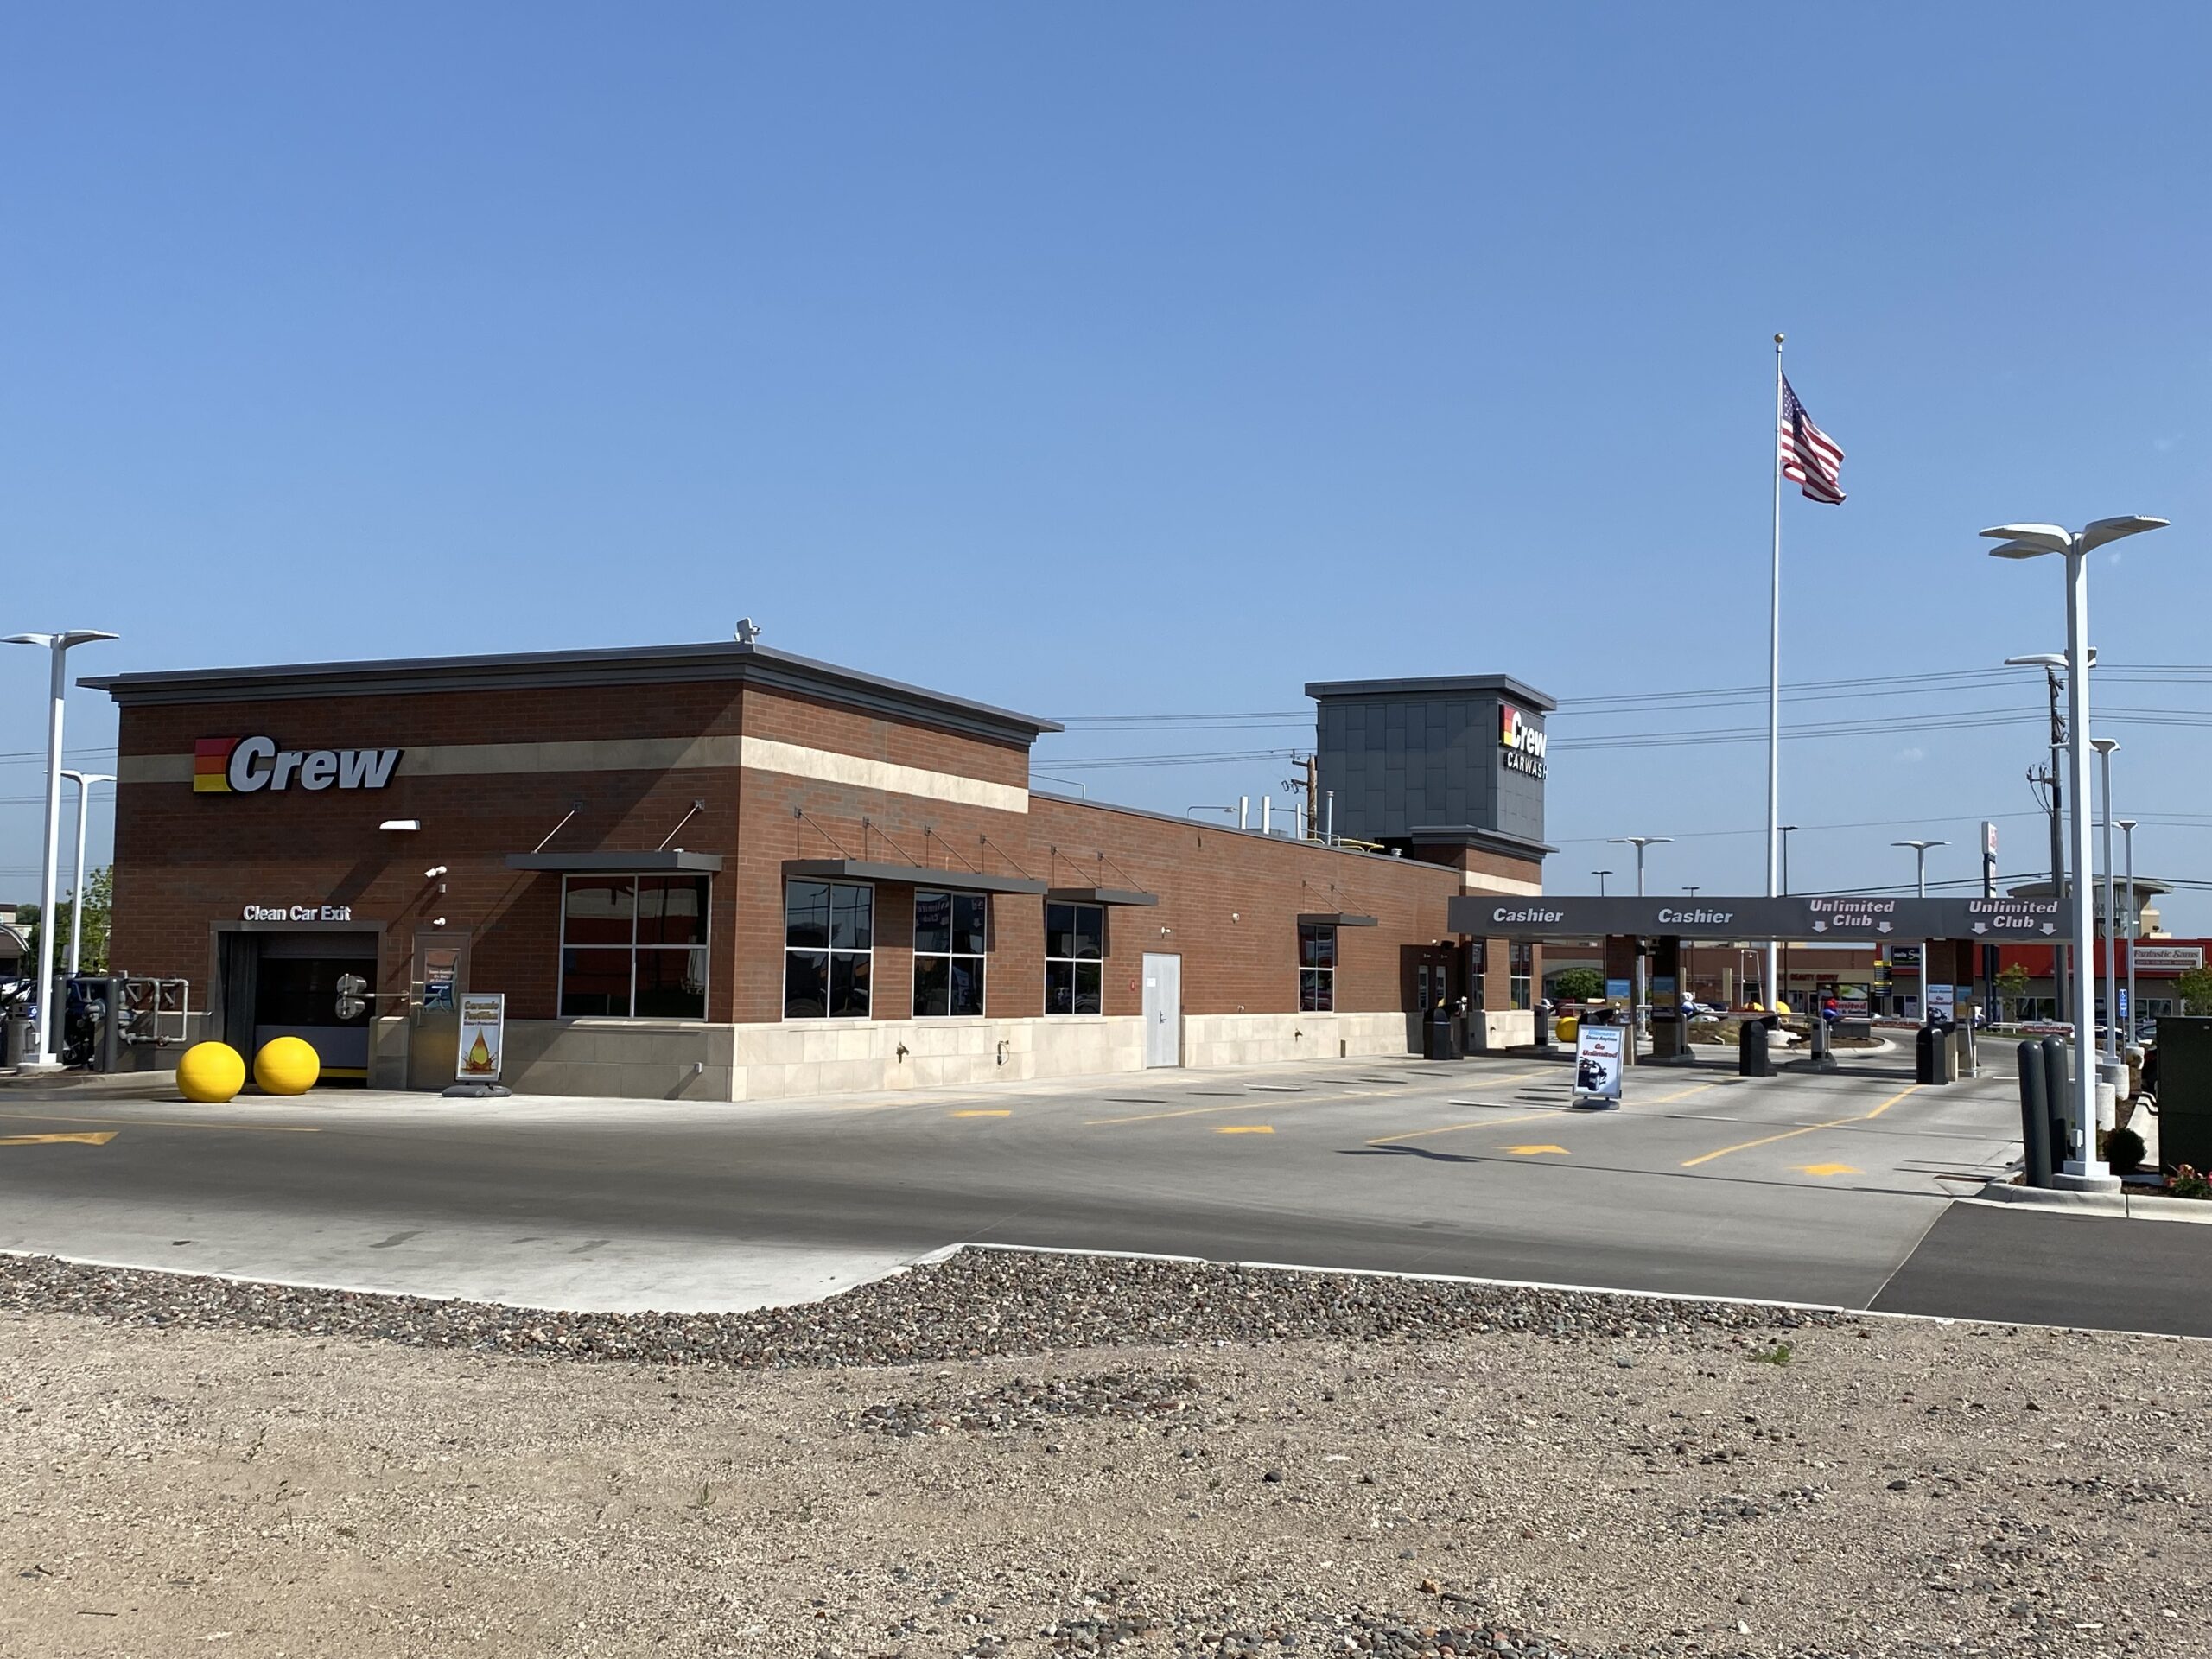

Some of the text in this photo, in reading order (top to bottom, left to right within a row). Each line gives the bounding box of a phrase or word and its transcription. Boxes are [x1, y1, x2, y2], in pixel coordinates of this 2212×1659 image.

[1511, 711, 1548, 758] Crew
[228, 735, 401, 792] Crew
[1507, 751, 1548, 779] CARWASH
[243, 904, 352, 921] Clean Car Exit
[1809, 899, 1895, 913] Unlimited
[1968, 900, 2059, 913] Unlimited
[1492, 907, 1565, 923] Cashier
[1657, 908, 1734, 924] Cashier
[1832, 914, 1872, 927] Club
[1993, 915, 2035, 928] Club
[2172, 950, 2199, 958] Sams
